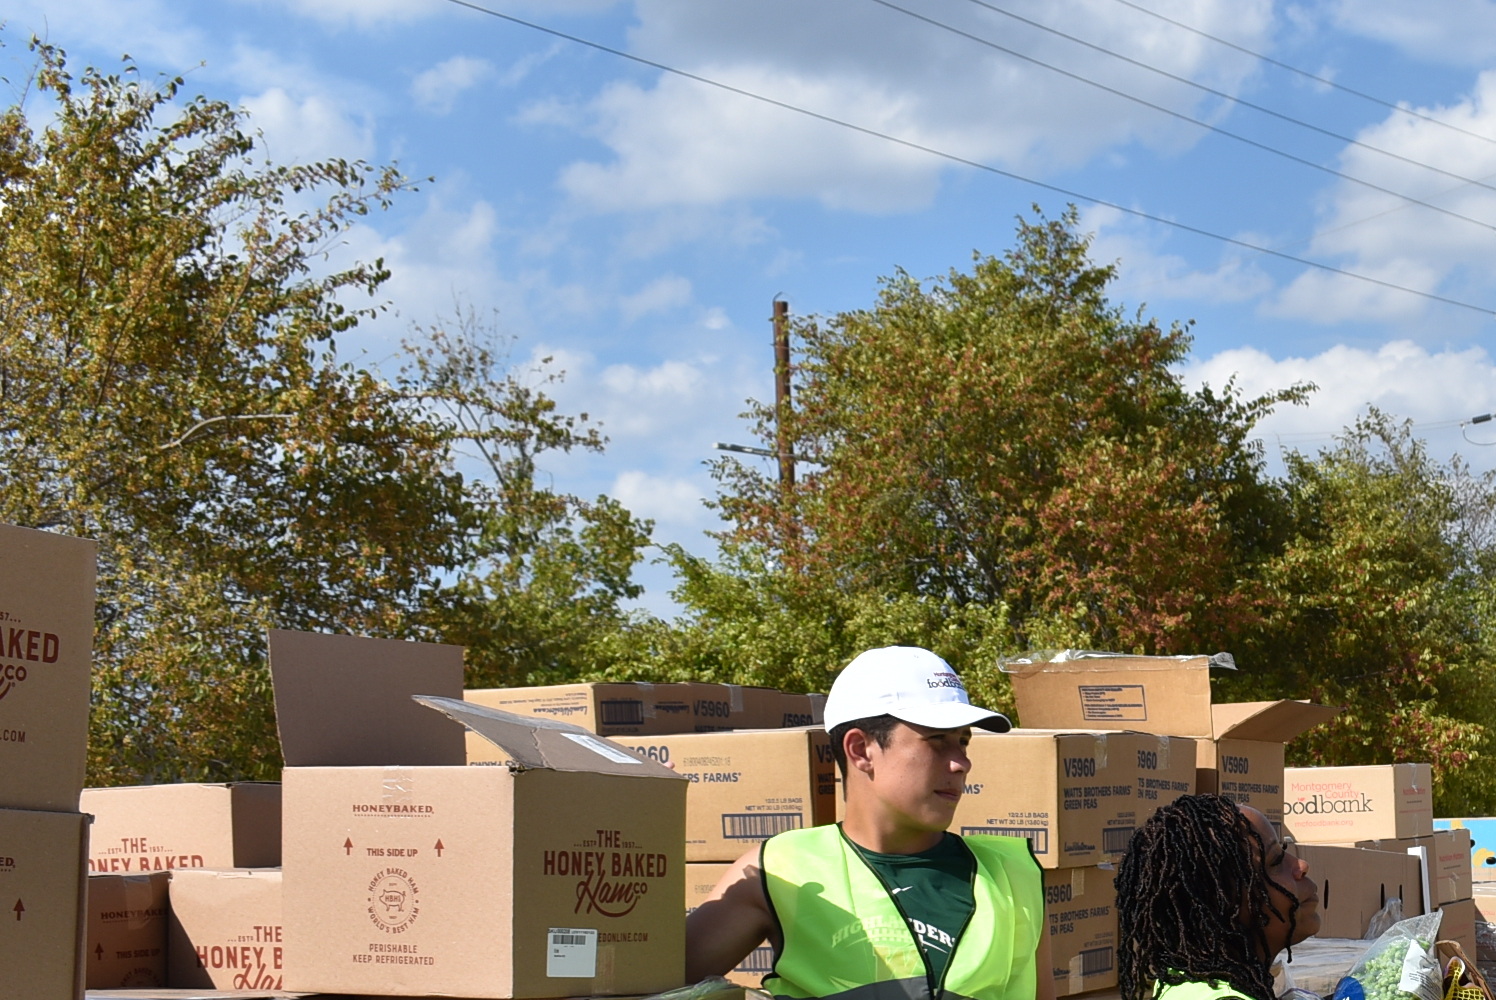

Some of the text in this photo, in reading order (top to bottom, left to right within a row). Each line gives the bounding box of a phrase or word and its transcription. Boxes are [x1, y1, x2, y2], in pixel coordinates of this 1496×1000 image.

[0, 627, 59, 663] KED
[1063, 757, 1096, 778] V5960
[1221, 755, 1249, 774] V5960
[1145, 778, 1171, 790] BROTHERS
[1221, 782, 1238, 791] WATTS
[1238, 782, 1262, 793] BROTHERS
[1291, 782, 1352, 792] Montgomery
[1063, 787, 1082, 798] WATTS
[1083, 786, 1112, 797] BROTHERS
[1112, 785, 1131, 796] FARMS
[1325, 790, 1359, 799] County
[352, 804, 433, 814] HONEYBAKED
[1063, 798, 1098, 810] GREEN PEAS
[1284, 793, 1374, 816] oodbank
[121, 838, 147, 853] THE
[596, 830, 621, 848] THE
[367, 848, 418, 857] THIS SIDE UP
[543, 850, 667, 877] HONEY BAKED
[368, 867, 420, 895] HONEY BAKED HAM
[392, 922, 409, 934] BEST
[409, 907, 420, 925] HAM
[1059, 906, 1110, 923] BROTHERS FARMS
[598, 932, 648, 943] EDONLINE.COM
[369, 943, 418, 954] PERISHABLE
[196, 945, 264, 969] HONEY
[352, 955, 434, 966] KEEP REFRIGERATED
